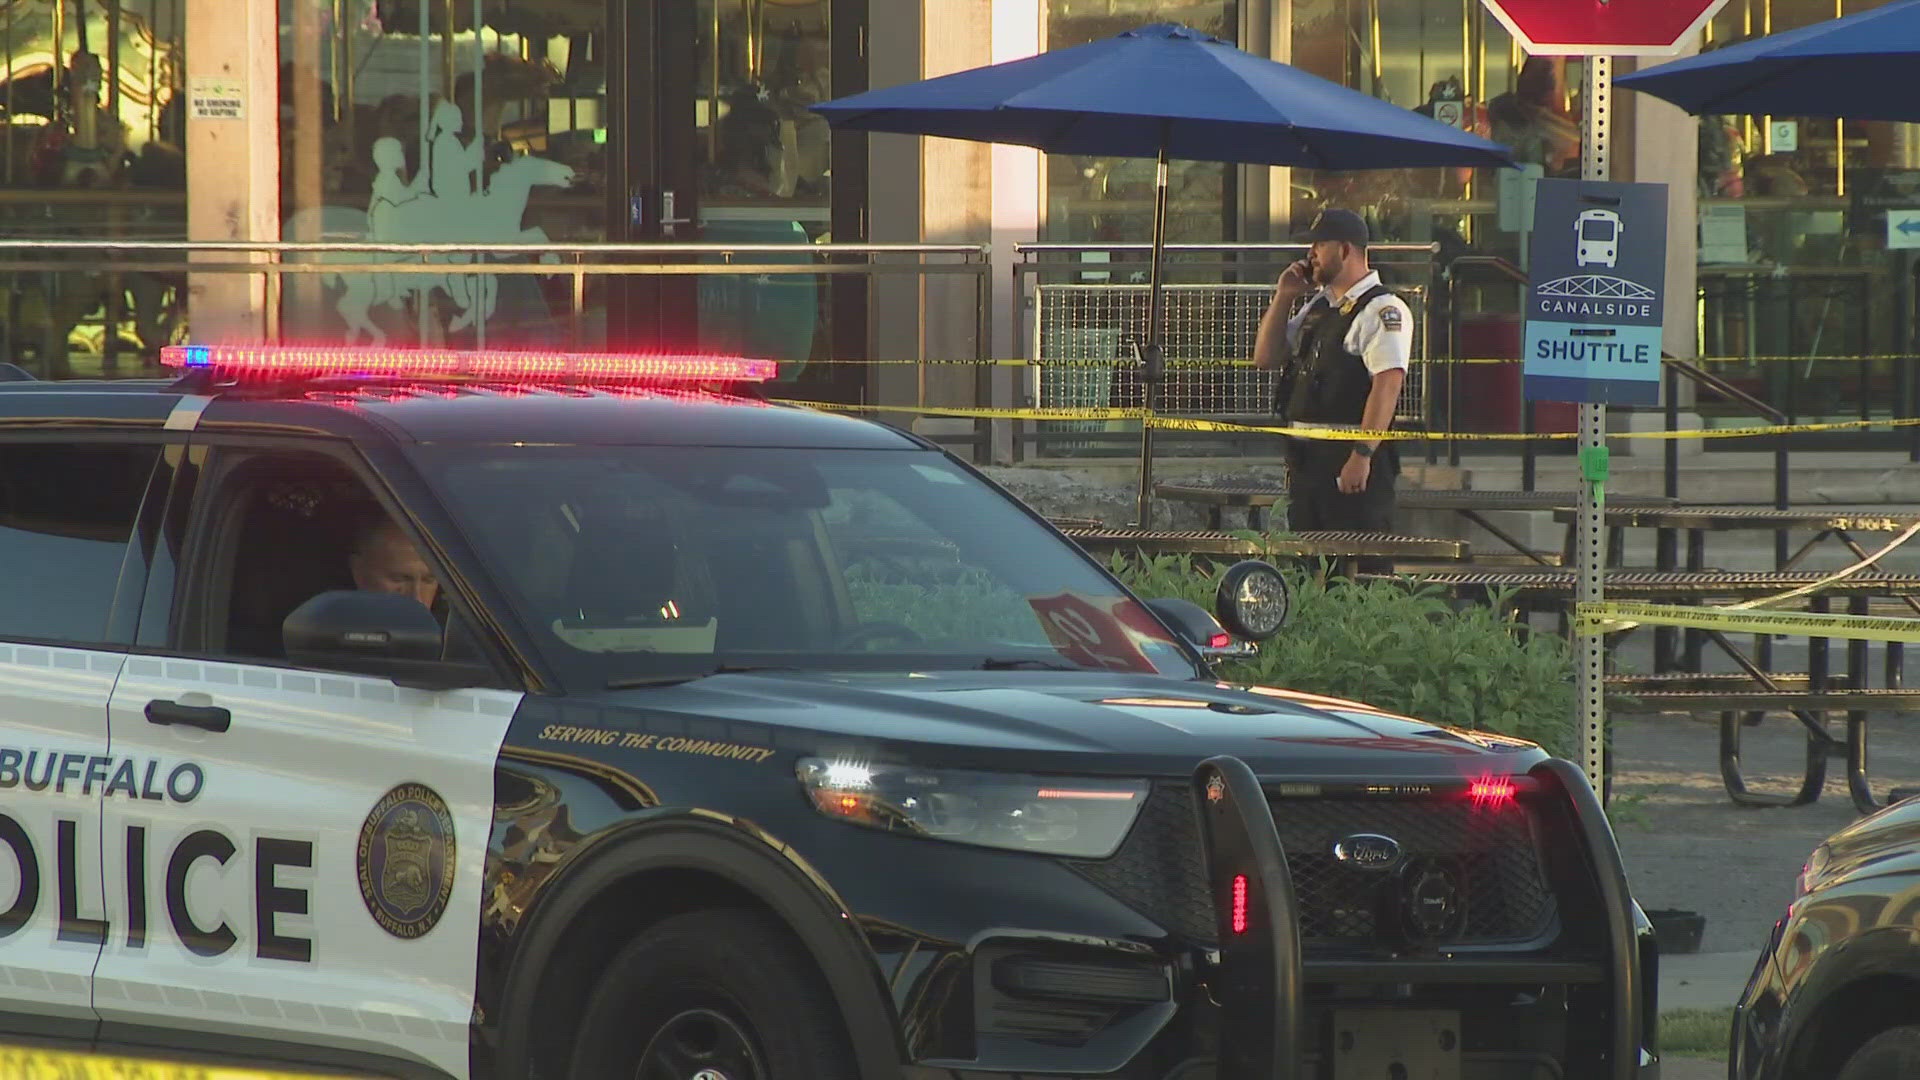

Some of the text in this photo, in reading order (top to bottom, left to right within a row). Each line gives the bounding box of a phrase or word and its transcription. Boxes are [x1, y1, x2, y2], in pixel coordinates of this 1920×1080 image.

[1540, 300, 1651, 317] CANALSIDE
[1536, 339, 1649, 364] SHUTTLE
[538, 725, 776, 763] SERVING THE COMMUNITY
[0, 749, 204, 803] BUFFALO
[407, 786, 442, 811] POLICE
